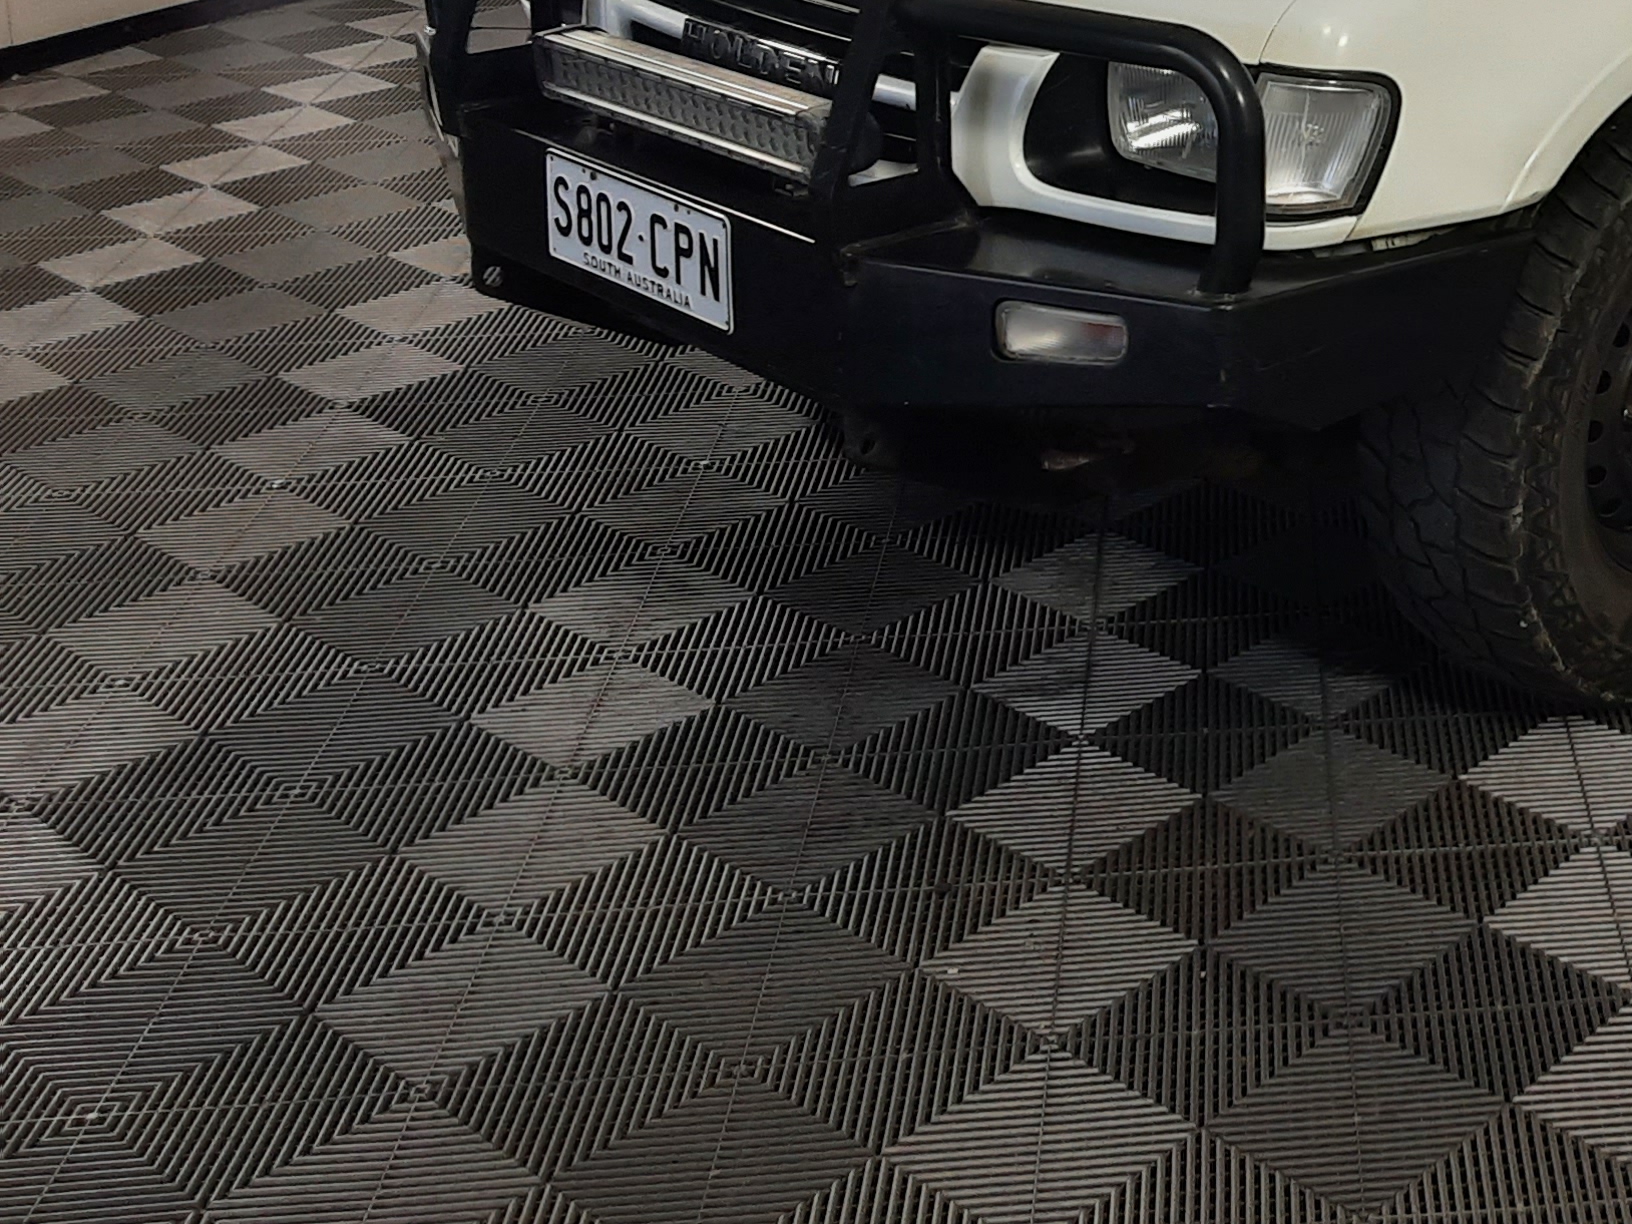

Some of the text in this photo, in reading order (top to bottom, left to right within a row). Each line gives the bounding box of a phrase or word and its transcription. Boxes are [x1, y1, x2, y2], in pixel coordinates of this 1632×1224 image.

[684, 20, 841, 91] HOLDEN
[583, 252, 693, 309] SOUTH AUSTRALIA
